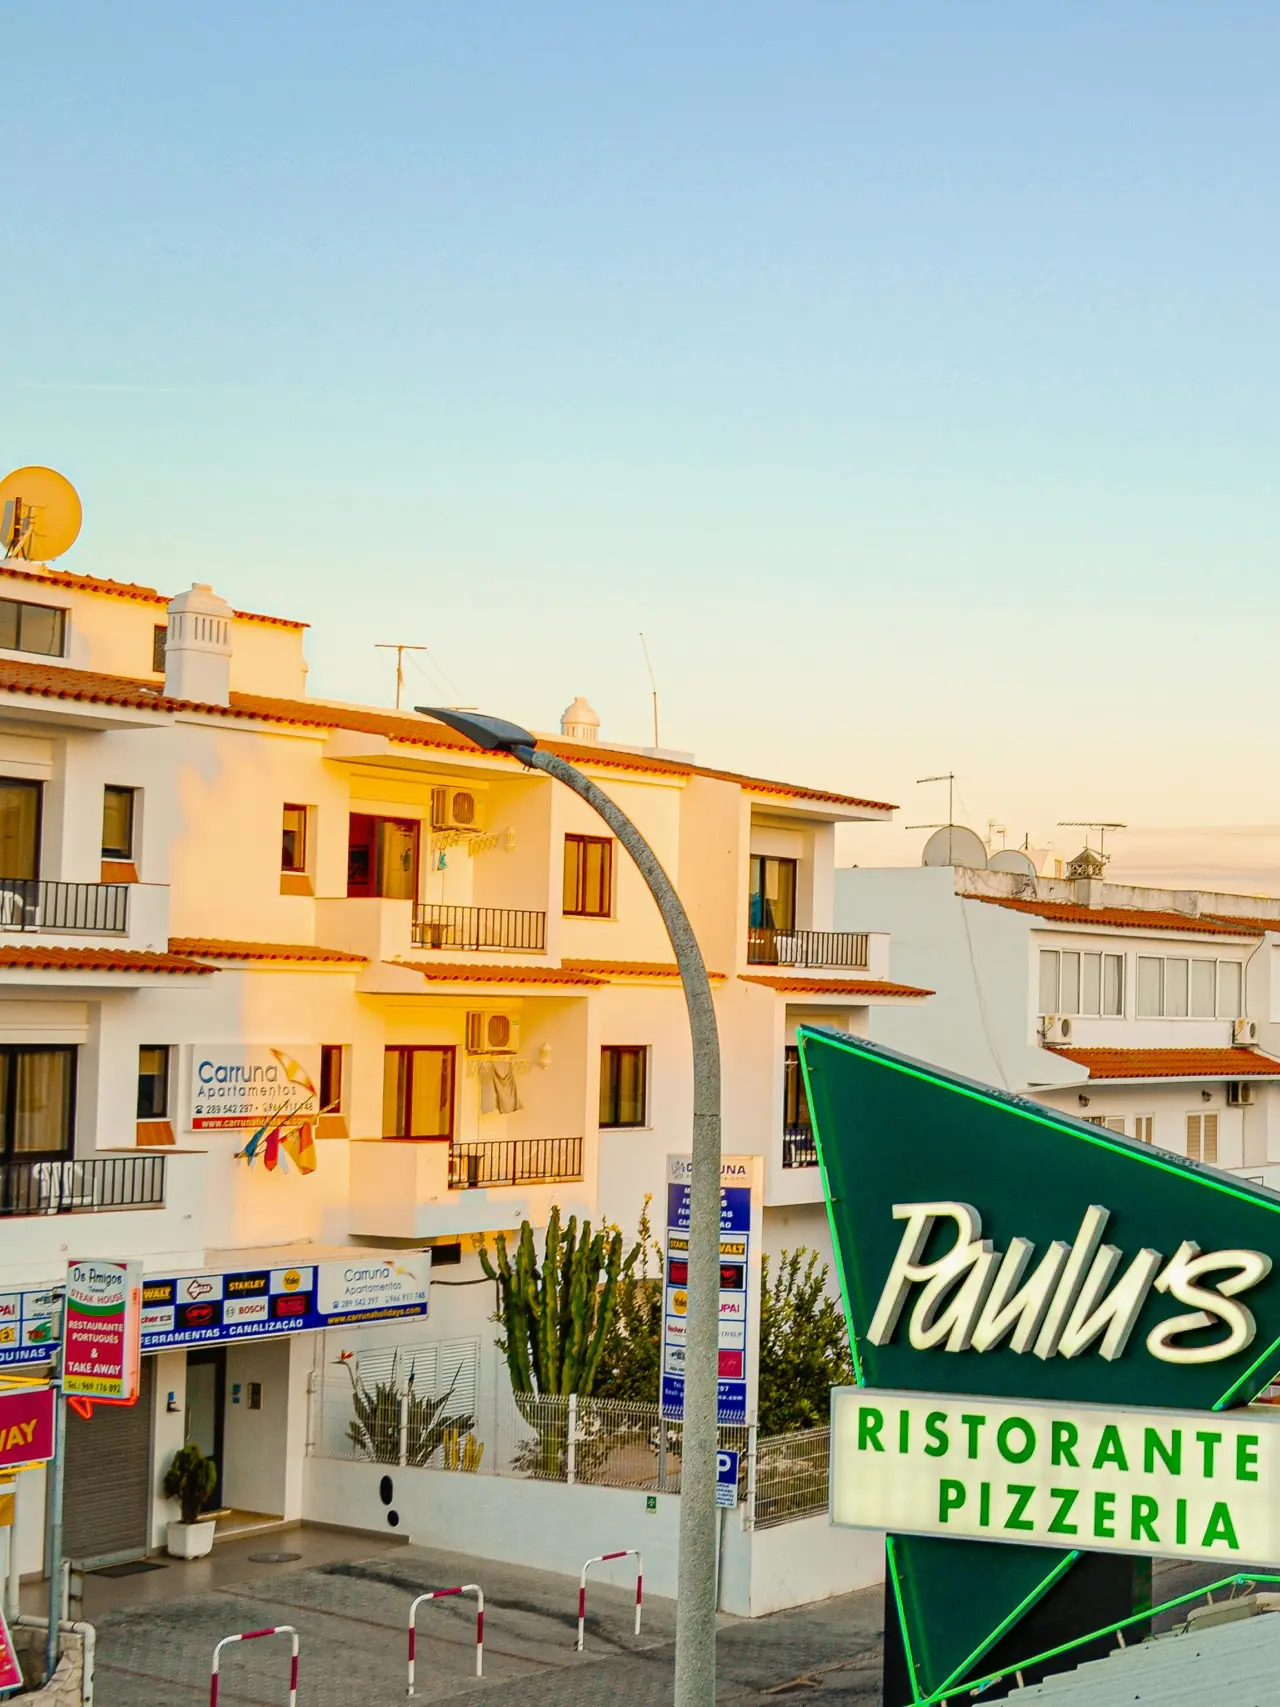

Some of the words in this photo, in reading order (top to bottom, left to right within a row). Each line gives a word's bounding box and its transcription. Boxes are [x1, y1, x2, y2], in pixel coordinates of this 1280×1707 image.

[198, 1061, 278, 1083] Carruna
[197, 1084, 297, 1099] Apartamentos
[89, 1268, 122, 1287] Amigos
[344, 1268, 390, 1282] Carruna
[228, 1279, 267, 1291] STANLEY
[344, 1282, 402, 1295] Apartamentos
[71, 1289, 94, 1303] STEAK
[97, 1292, 124, 1304] HOUSE
[238, 1304, 266, 1315] BOSCH
[68, 1320, 124, 1332] RESTAURANTE
[229, 1318, 304, 1336] CANALIZAÇÃO
[91, 1347, 99, 1359] &
[67, 1361, 93, 1373] TAKE
[93, 1363, 121, 1375] AWAY
[857, 1407, 1260, 1482] RISTORANTE
[717, 1454, 731, 1481] P
[939, 1478, 1240, 1550] PIZZERIA
